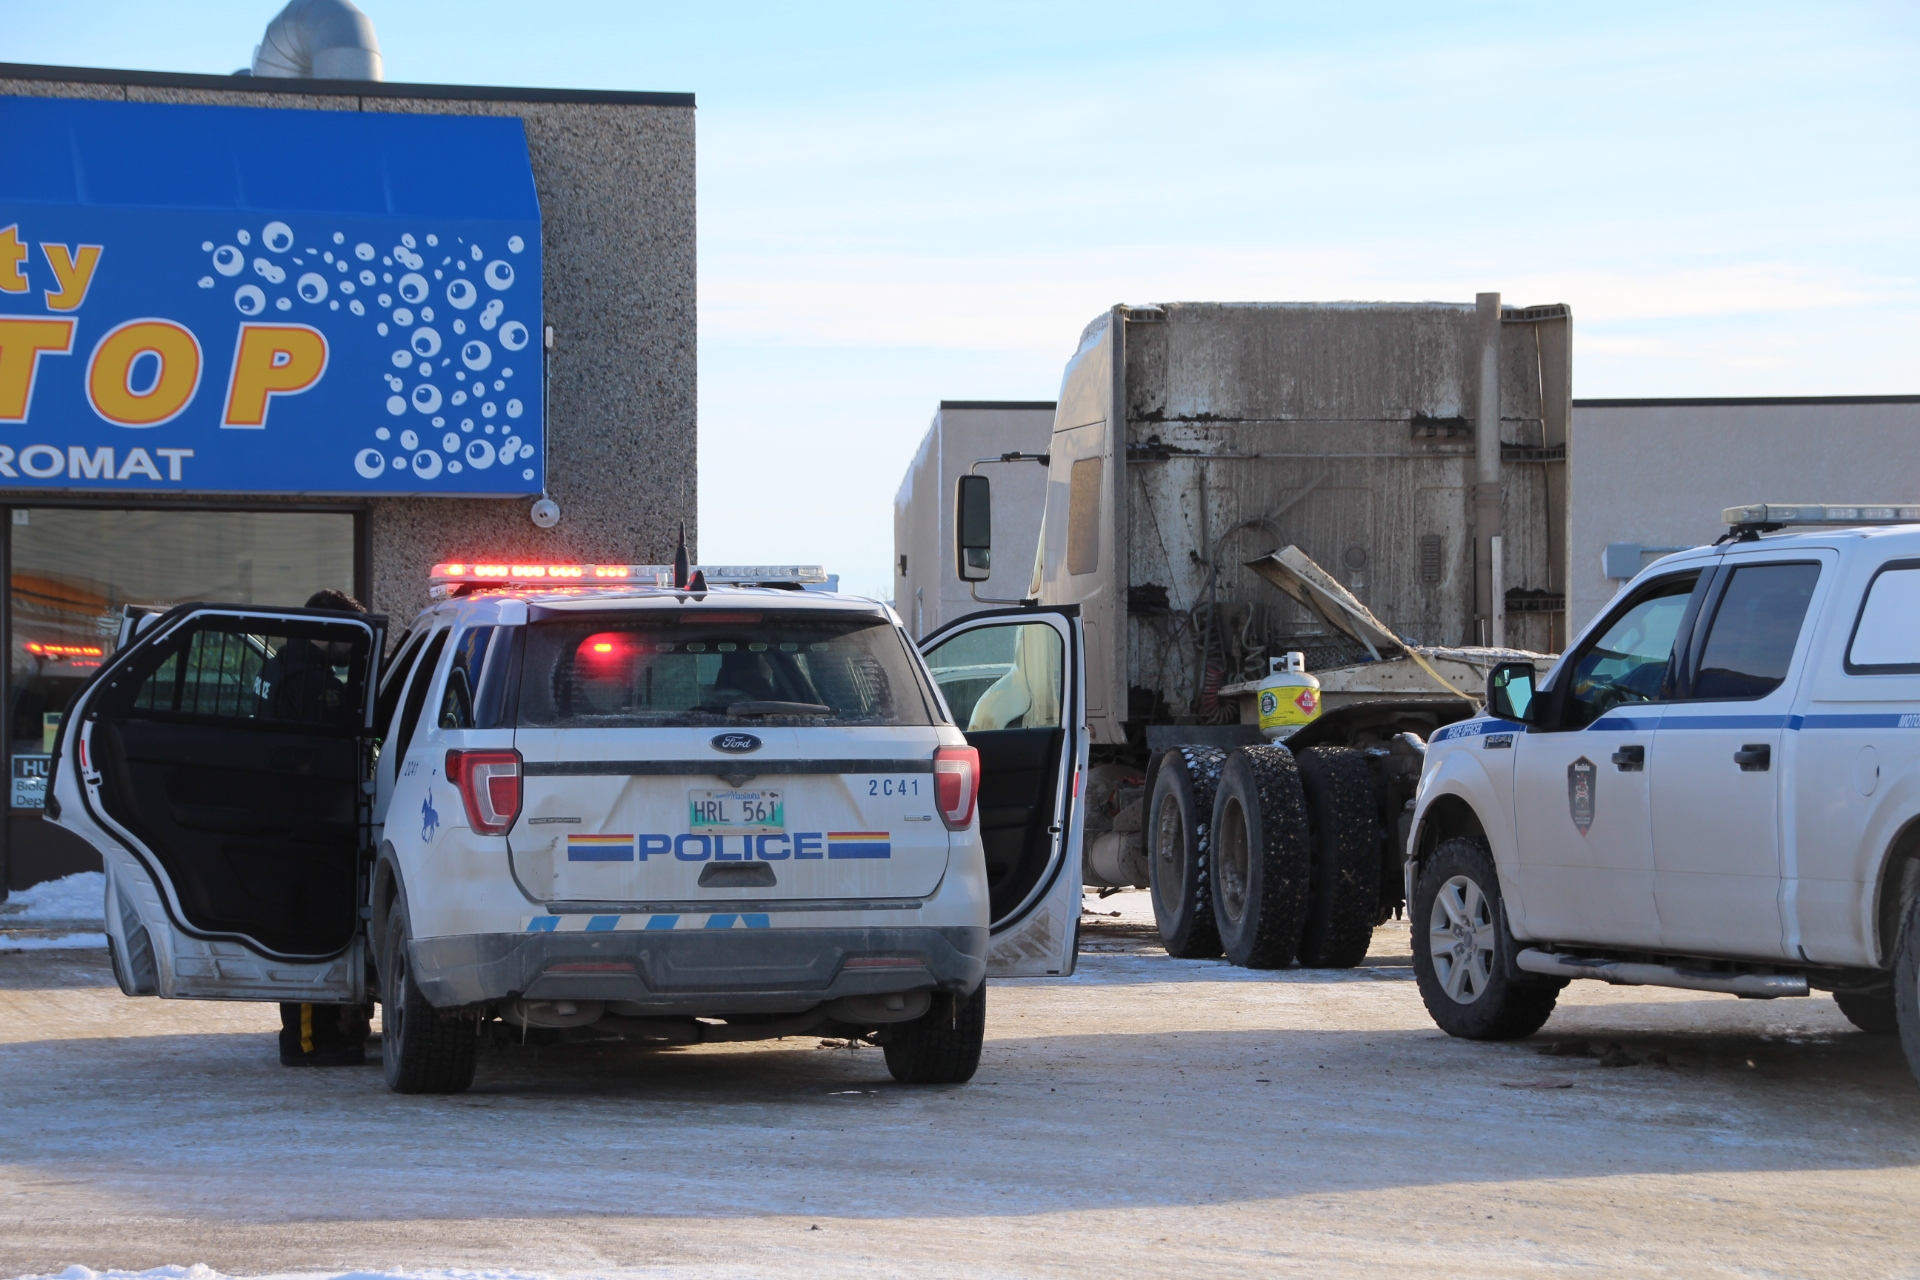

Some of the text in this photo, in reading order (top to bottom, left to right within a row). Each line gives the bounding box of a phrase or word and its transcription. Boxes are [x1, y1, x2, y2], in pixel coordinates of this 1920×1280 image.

[0, 223, 104, 312] ty
[0, 315, 329, 428] TOP
[0, 444, 194, 481] ROMAT
[253, 676, 271, 699] POICE
[1446, 722, 1483, 739] PEACE OFFICER
[1897, 714, 1920, 728] MOTO
[722, 735, 751, 748] Ford
[730, 790, 760, 800] Manitoba
[868, 778, 918, 796] 2C41
[16, 795, 45, 808] Dep
[694, 800, 775, 822] HRL 561
[638, 832, 824, 862] POLICE
